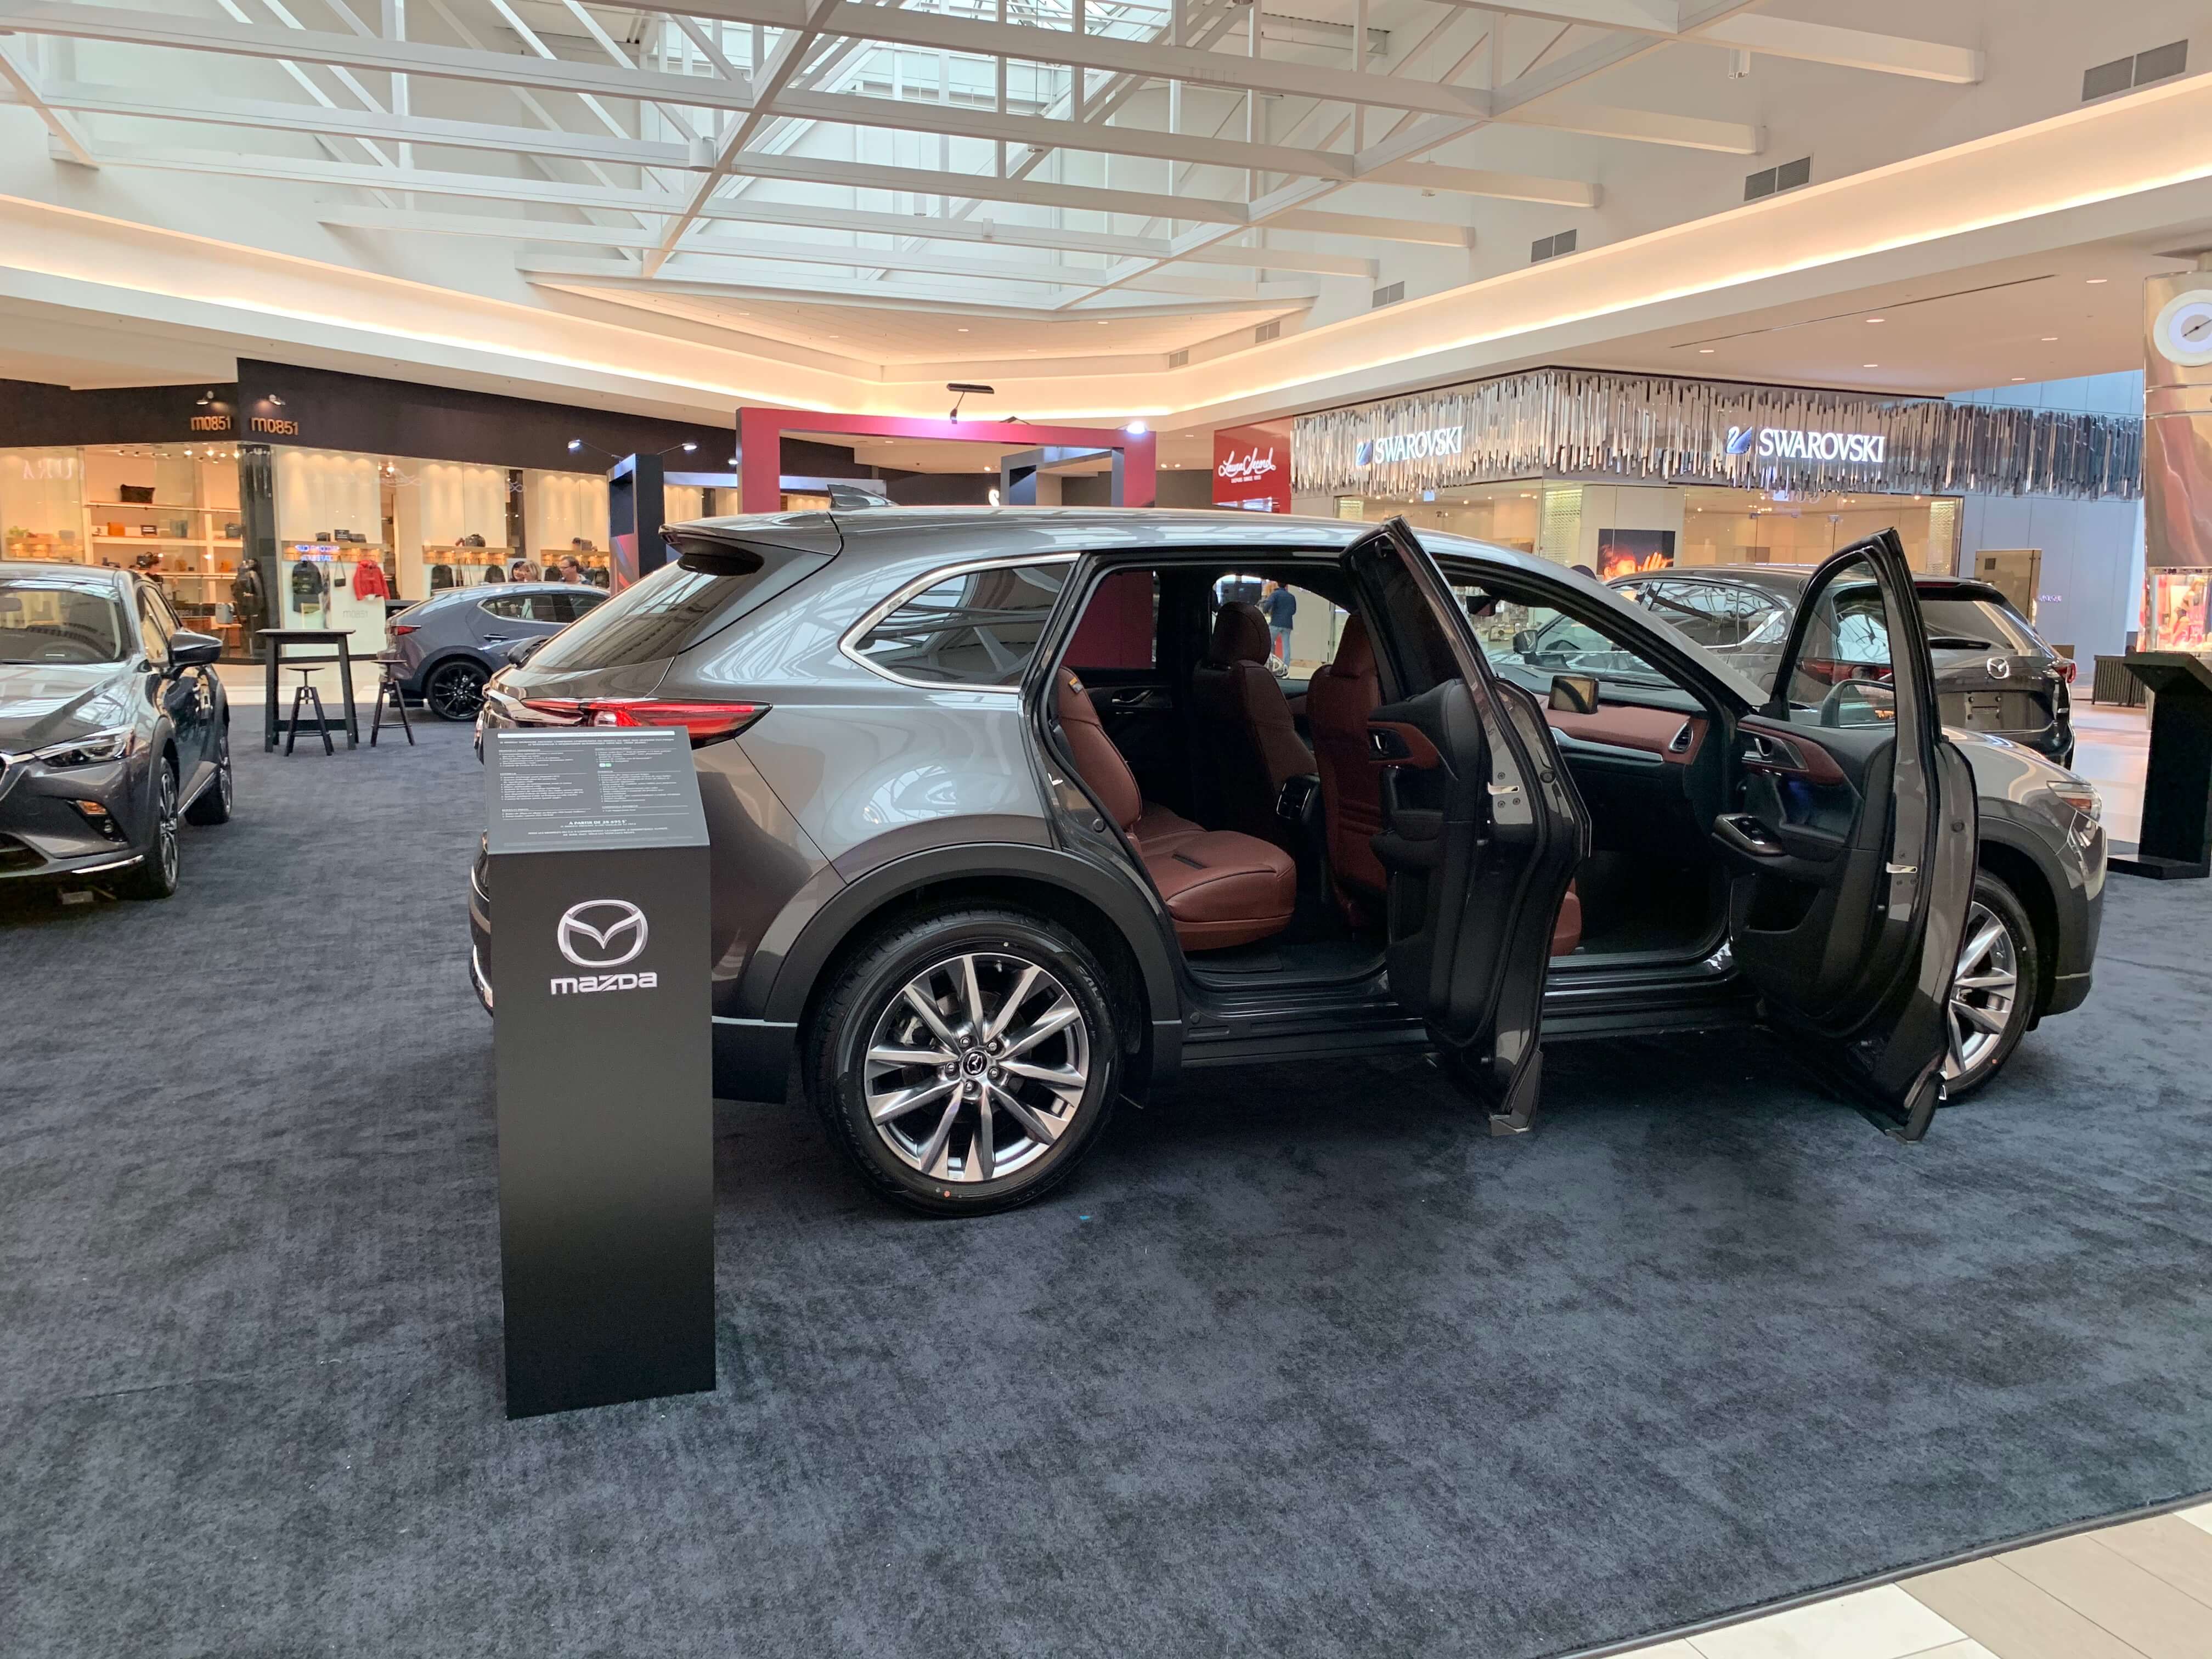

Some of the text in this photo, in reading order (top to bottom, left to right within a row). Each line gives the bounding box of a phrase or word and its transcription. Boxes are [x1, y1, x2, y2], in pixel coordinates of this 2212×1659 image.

[190, 415, 231, 431] m0851
[251, 417, 299, 436] m0851
[1374, 426, 1463, 464] SWAROVSKI
[1759, 428, 1885, 463] SWAROVSKI
[1218, 447, 1276, 477] Laura Secord
